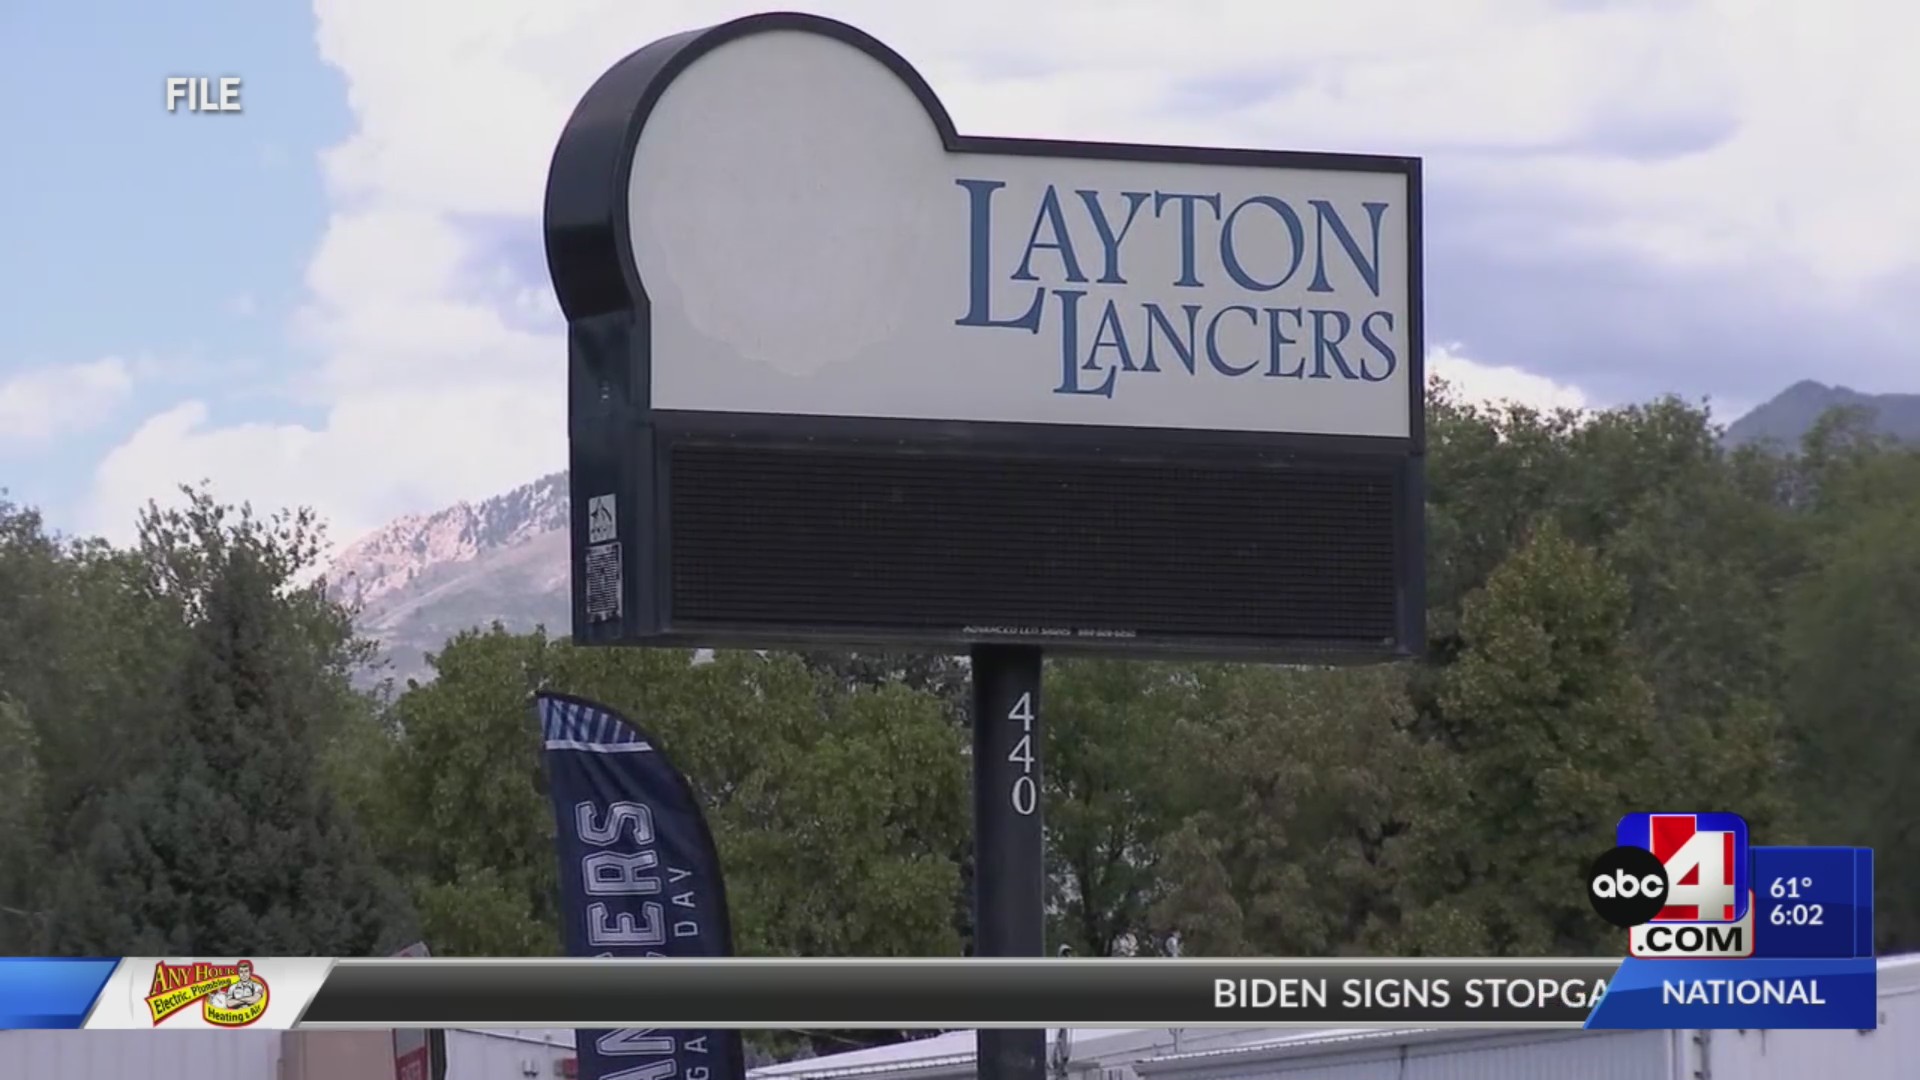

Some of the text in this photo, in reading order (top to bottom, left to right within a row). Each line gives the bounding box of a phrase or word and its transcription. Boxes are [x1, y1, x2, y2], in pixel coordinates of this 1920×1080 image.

[955, 179, 1389, 334] LAYTON
[1052, 289, 1396, 398] LANCERS
[1008, 691, 1036, 815] 440
[667, 866, 698, 938] DAY
